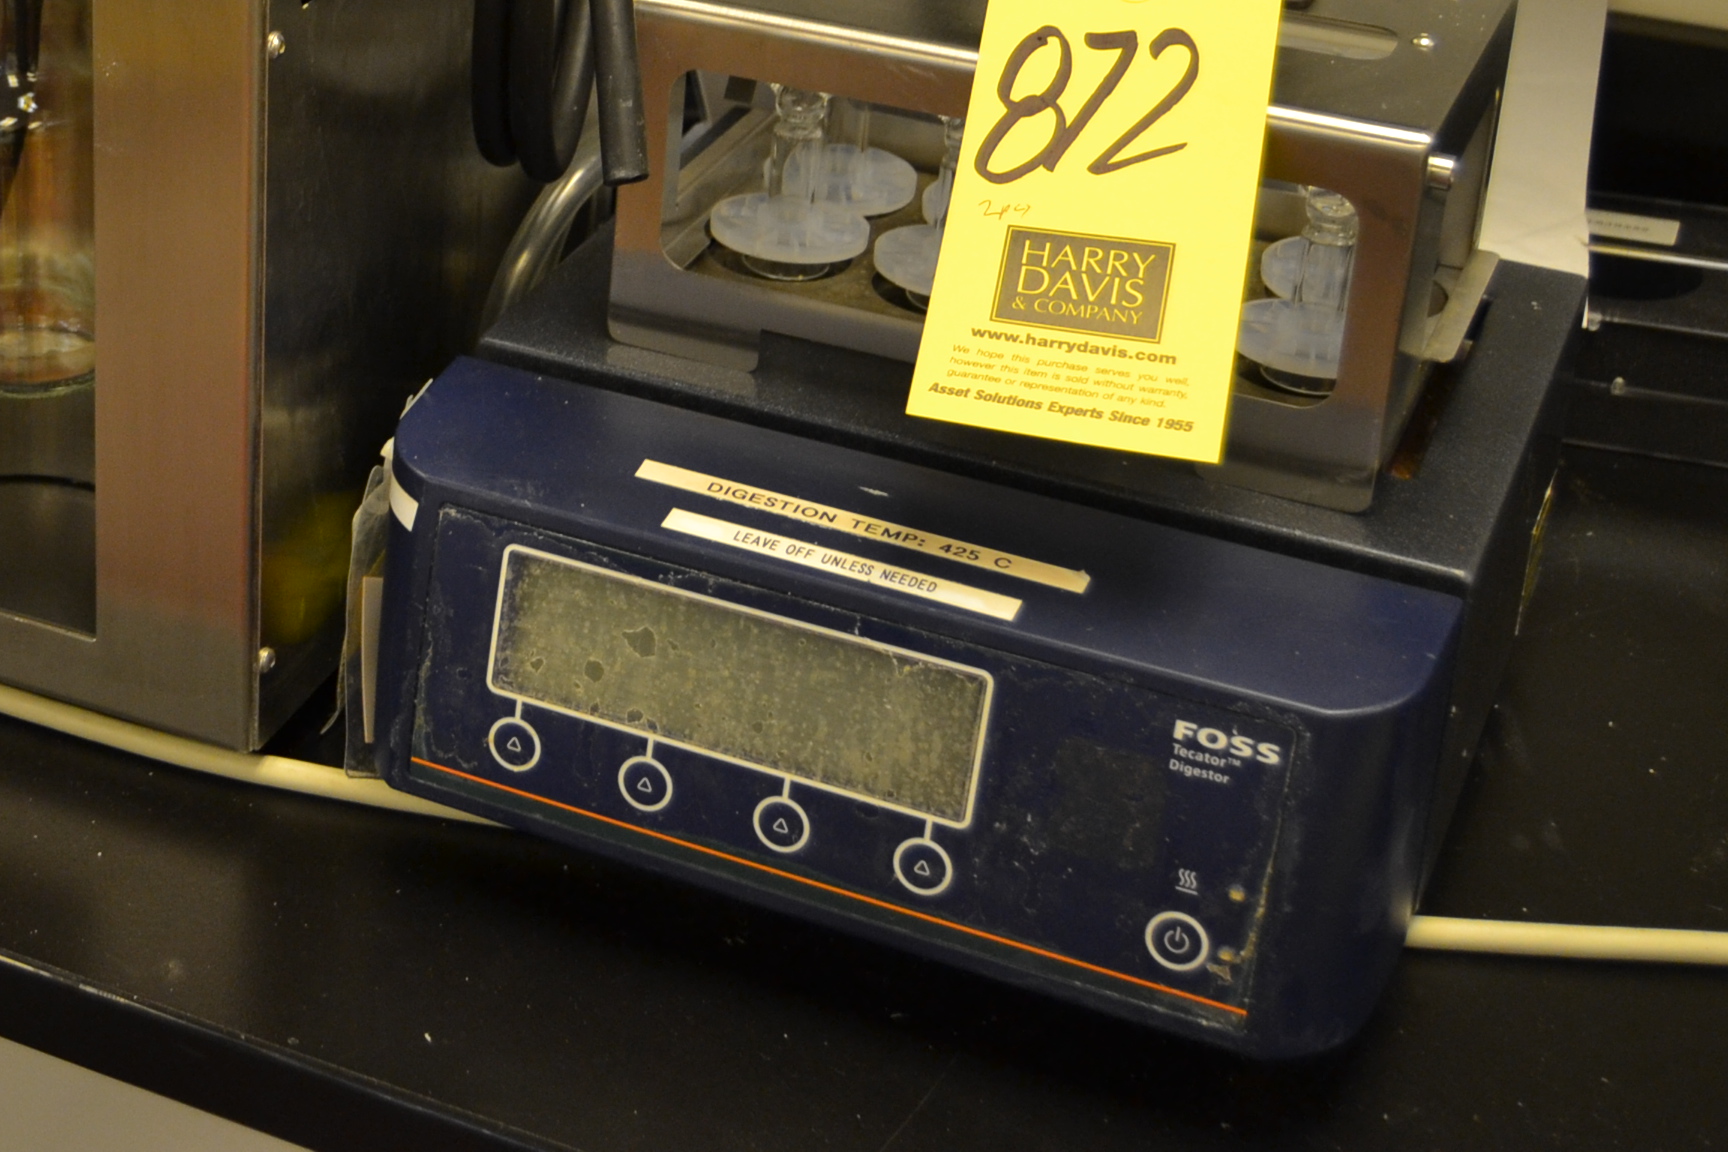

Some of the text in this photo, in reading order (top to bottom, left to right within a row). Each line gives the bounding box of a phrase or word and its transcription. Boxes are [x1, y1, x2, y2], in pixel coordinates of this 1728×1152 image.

[973, 25, 1200, 185] 872
[1021, 239, 1156, 279] HARRY
[1017, 265, 1144, 308] DAVIS
[1011, 296, 1143, 325] & COMPANY
[952, 344, 970, 354] We
[976, 348, 1004, 360] hope
[1011, 353, 1031, 364] this
[1037, 358, 1088, 372] purchase
[1095, 367, 1131, 378] serves
[1137, 373, 1158, 383] you
[971, 327, 1177, 365] www.harrydavis.com
[946, 369, 1167, 408] guarantee or representation of any kind.
[949, 356, 995, 370] however
[1000, 364, 1019, 374] this
[1023, 367, 1048, 378] item
[1052, 372, 1061, 381] is
[1065, 374, 1089, 385] sold
[1093, 379, 1134, 391] without
[928, 382, 1194, 432] Asset Solutions Experts Since 1955
[706, 482, 1013, 570] DIGESTION TEMP: 425 C
[733, 530, 938, 594] LEAVE OFF UNLESS NEEDED
[1173, 719, 1280, 765] FOSS
[1169, 759, 1230, 784] Digestor
